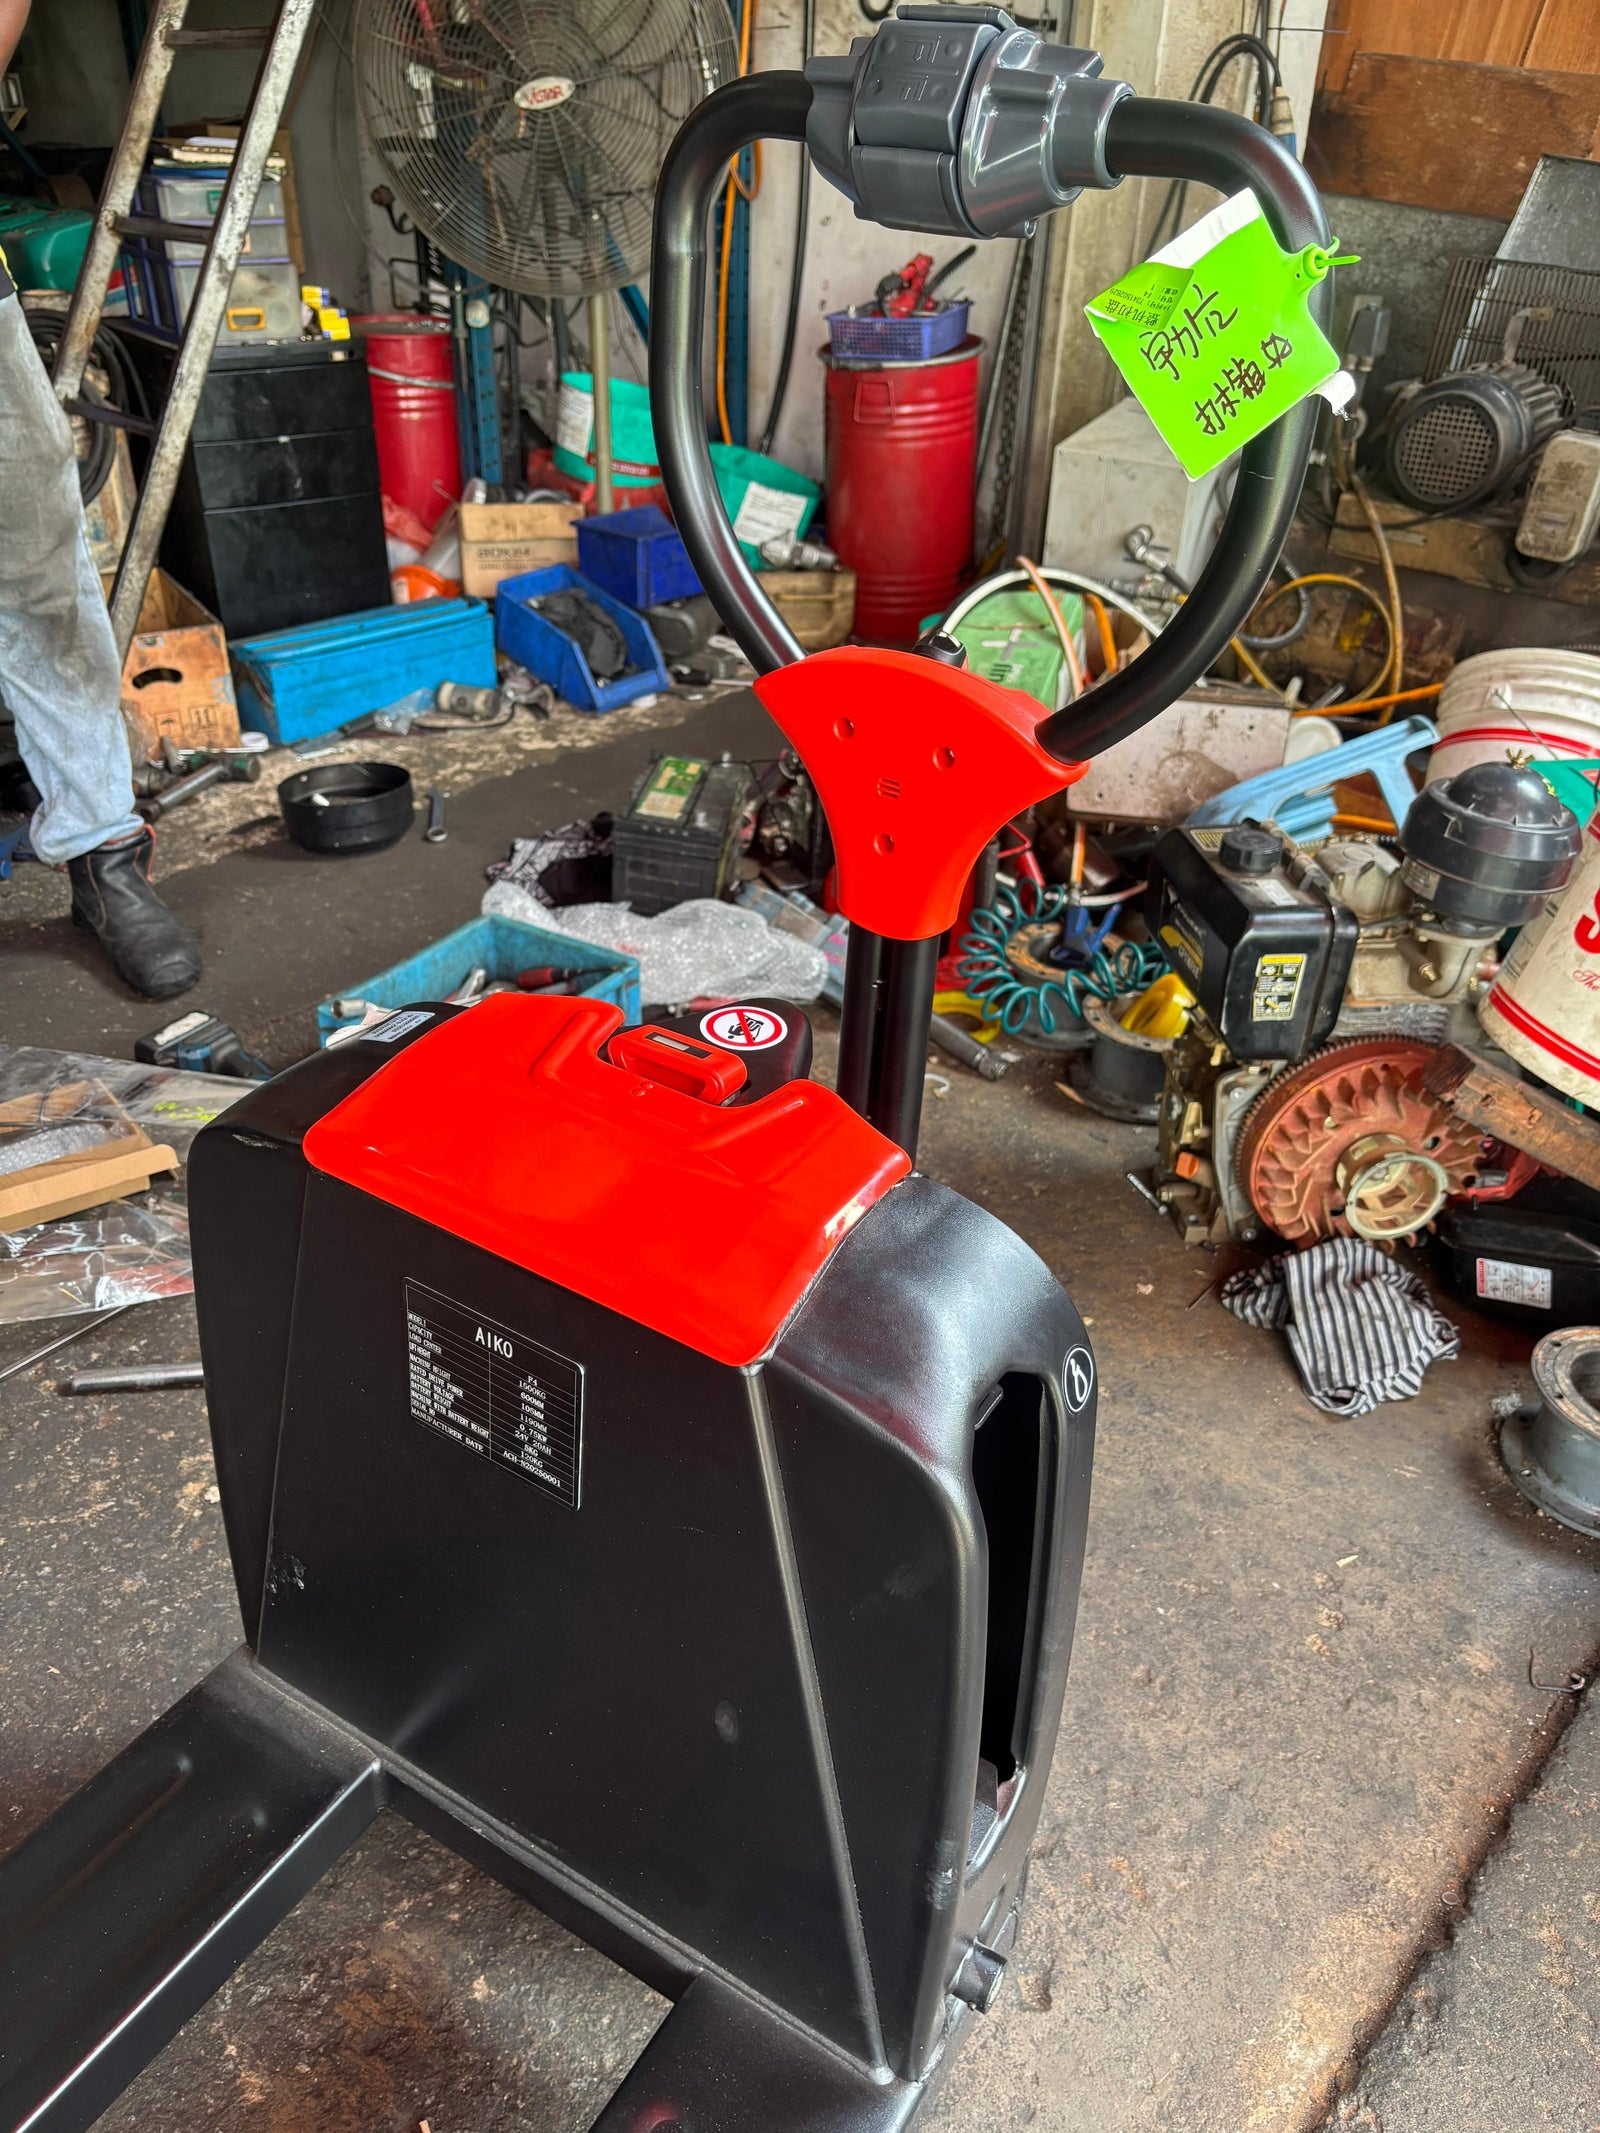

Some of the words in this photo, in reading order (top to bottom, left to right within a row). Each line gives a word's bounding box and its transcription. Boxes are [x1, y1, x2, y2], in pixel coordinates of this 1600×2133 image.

[409, 1332, 422, 1344] LOAD
[423, 1339, 442, 1354] CENTER
[475, 1326, 514, 1359] AIKO
[409, 1353, 431, 1370] MACHINE
[433, 1365, 451, 1380] HEIGHT
[410, 1364, 426, 1376] RATED
[428, 1372, 445, 1387] DRIVE
[446, 1382, 464, 1397] POWER
[410, 1371, 431, 1388] BATTERY
[433, 1384, 455, 1401] VOLTAGE
[519, 1380, 546, 1400] 1500KG
[411, 1381, 431, 1397] BATTERY
[434, 1393, 452, 1408] WEIGHT
[520, 1392, 544, 1410] 600MM
[411, 1390, 432, 1407] MACHINE
[434, 1402, 447, 1415] WITH
[448, 1408, 469, 1427] BATTERY
[471, 1422, 489, 1438] WEIGHT
[520, 1413, 548, 1433] 1190MM
[411, 1406, 462, 1440] MANUFACTURER
[466, 1436, 483, 1453] DATE
[514, 1430, 529, 1442] 24V
[532, 1440, 552, 1455] 20AH
[520, 1451, 543, 1468] 120KG
